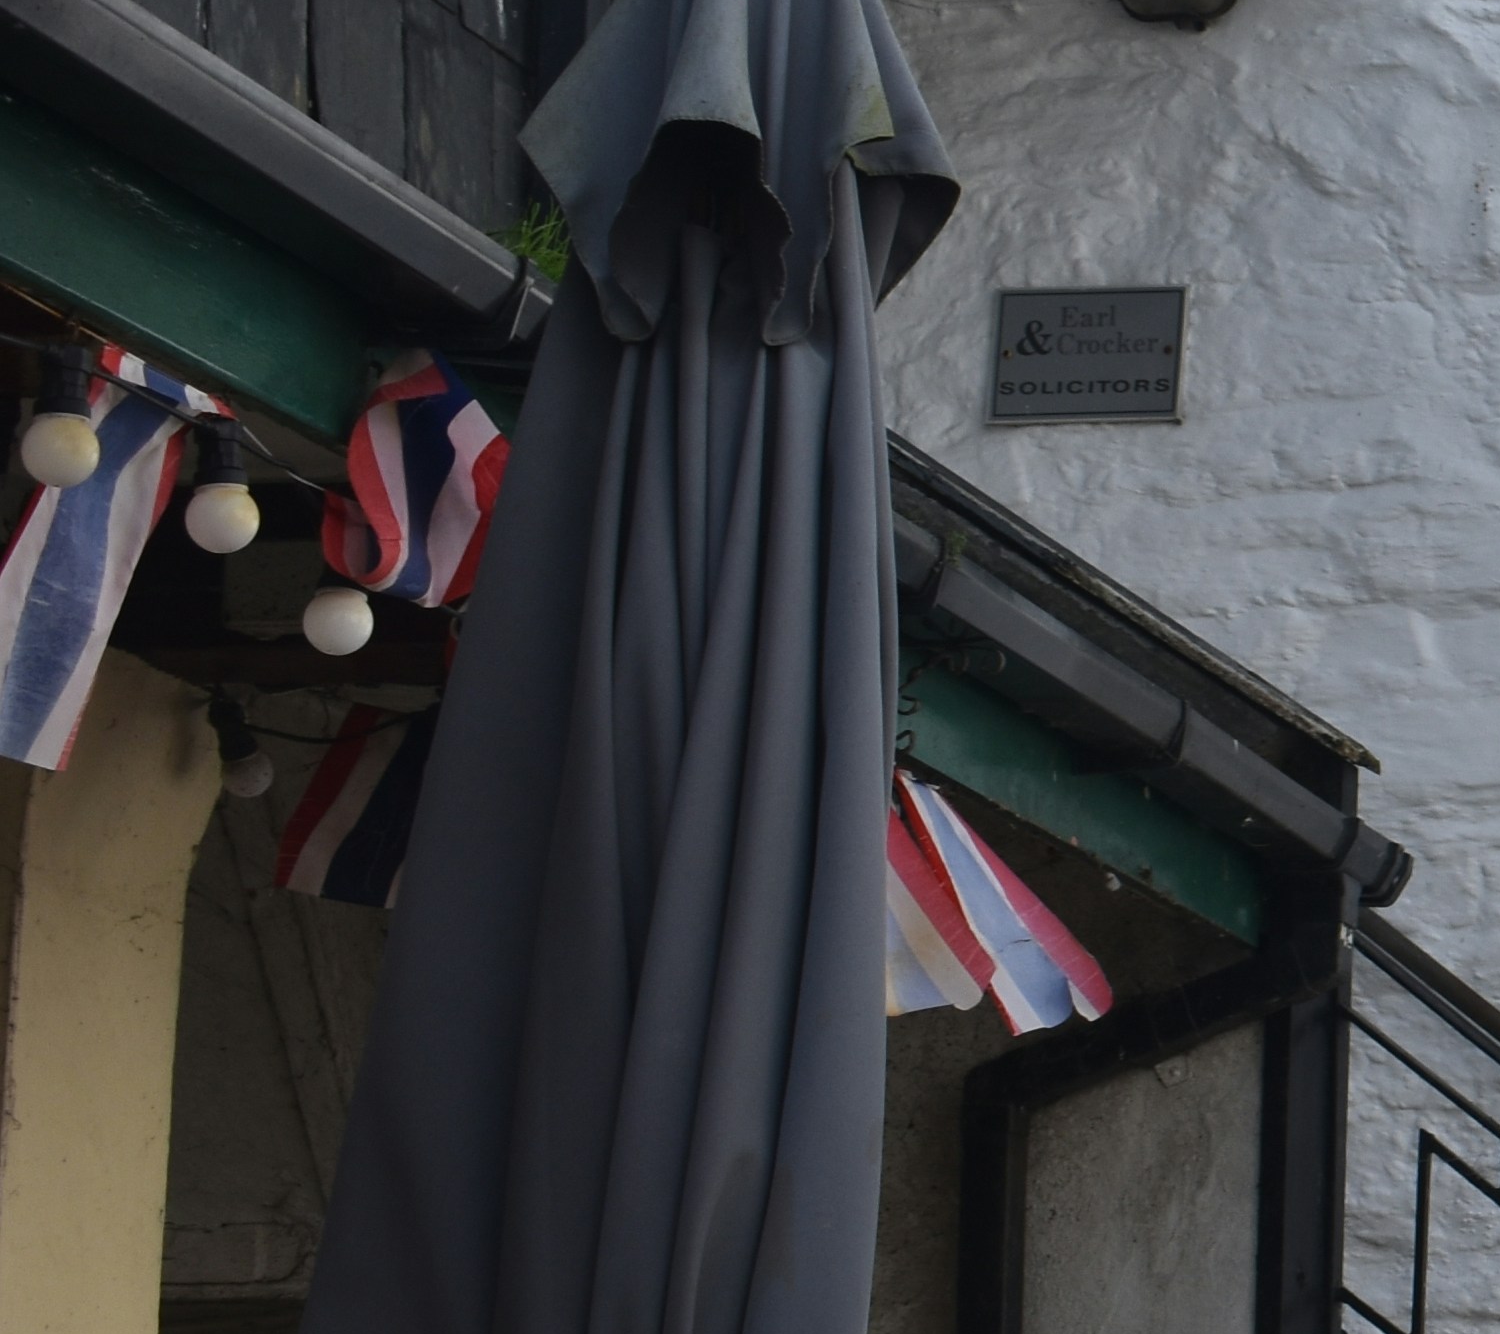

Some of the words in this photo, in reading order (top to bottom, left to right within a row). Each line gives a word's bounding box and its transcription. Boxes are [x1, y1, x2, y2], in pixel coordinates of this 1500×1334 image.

[1059, 305, 1117, 328] Earl
[1016, 320, 1052, 356] &
[1057, 331, 1159, 356] Crocker
[1001, 378, 1170, 395] SOLICITORS
